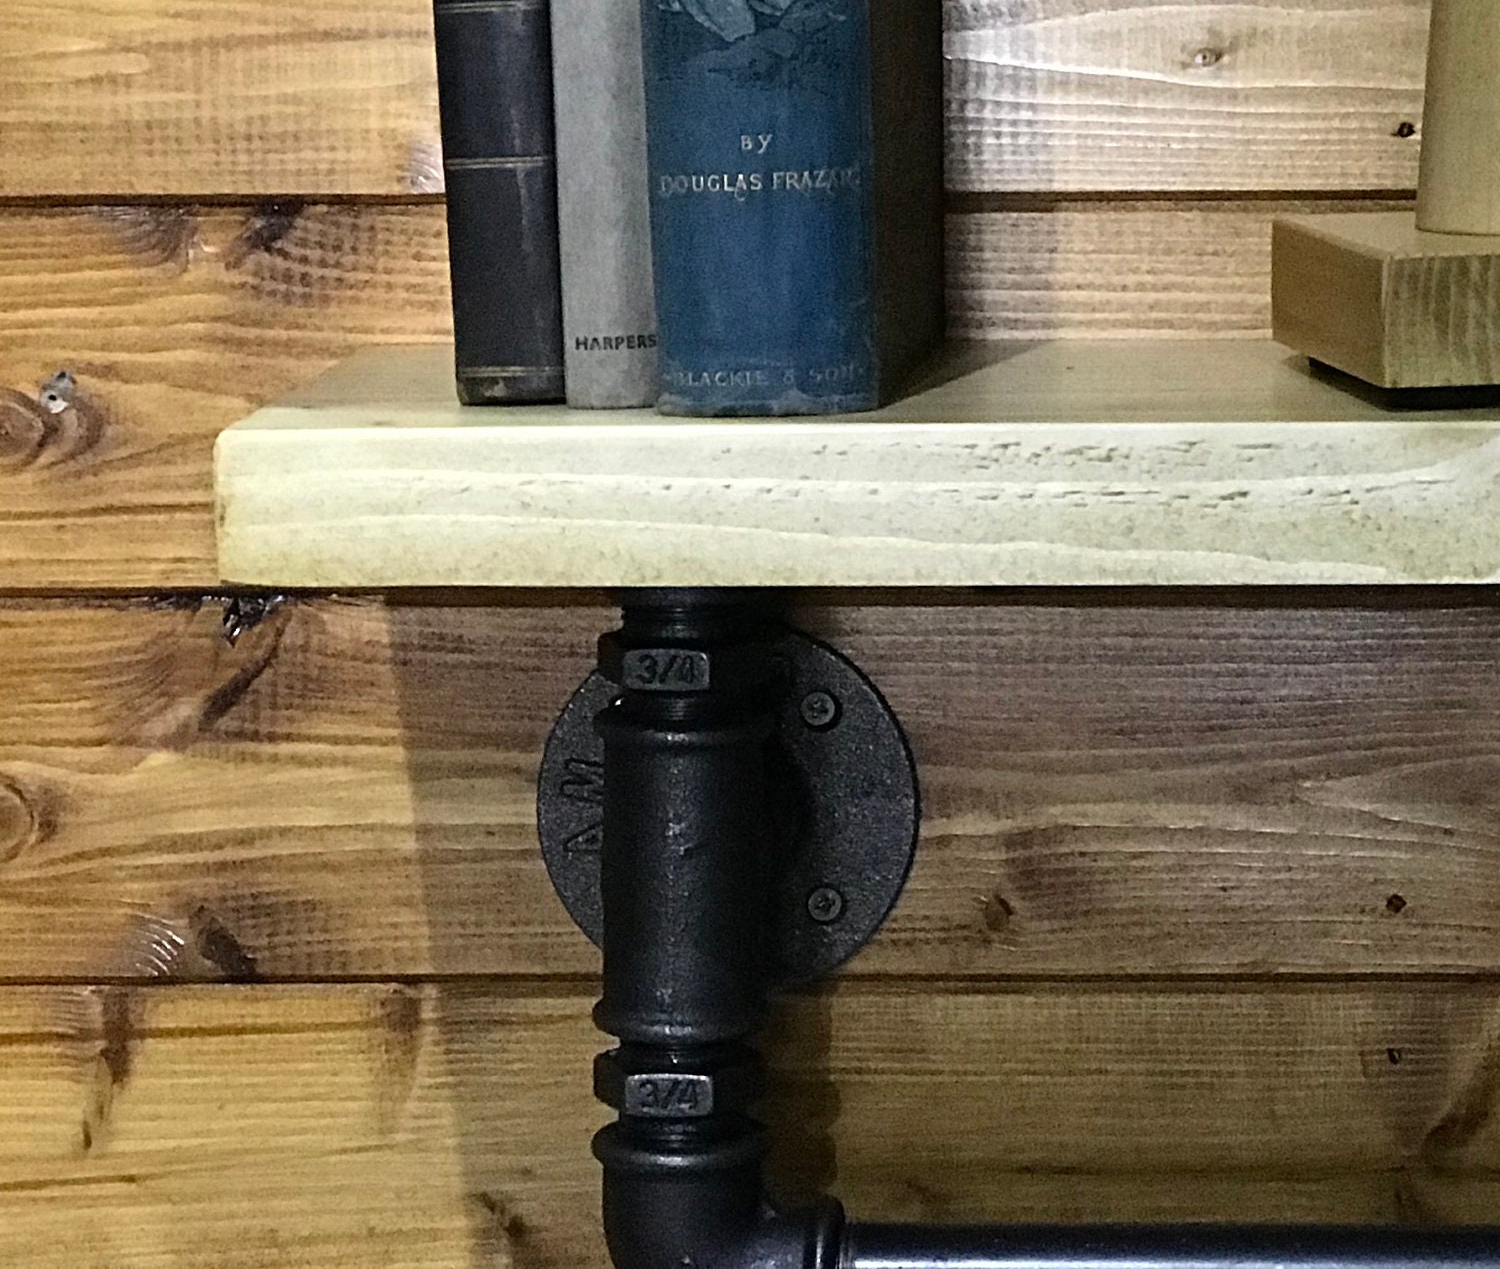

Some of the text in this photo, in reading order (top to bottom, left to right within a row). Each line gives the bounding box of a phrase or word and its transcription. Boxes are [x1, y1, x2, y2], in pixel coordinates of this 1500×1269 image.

[740, 134, 773, 153] BY
[659, 173, 762, 201] DOUGLAS
[575, 334, 658, 351] HARPERS
[636, 654, 696, 685] 3/4
[639, 1079, 698, 1111] 3/4
